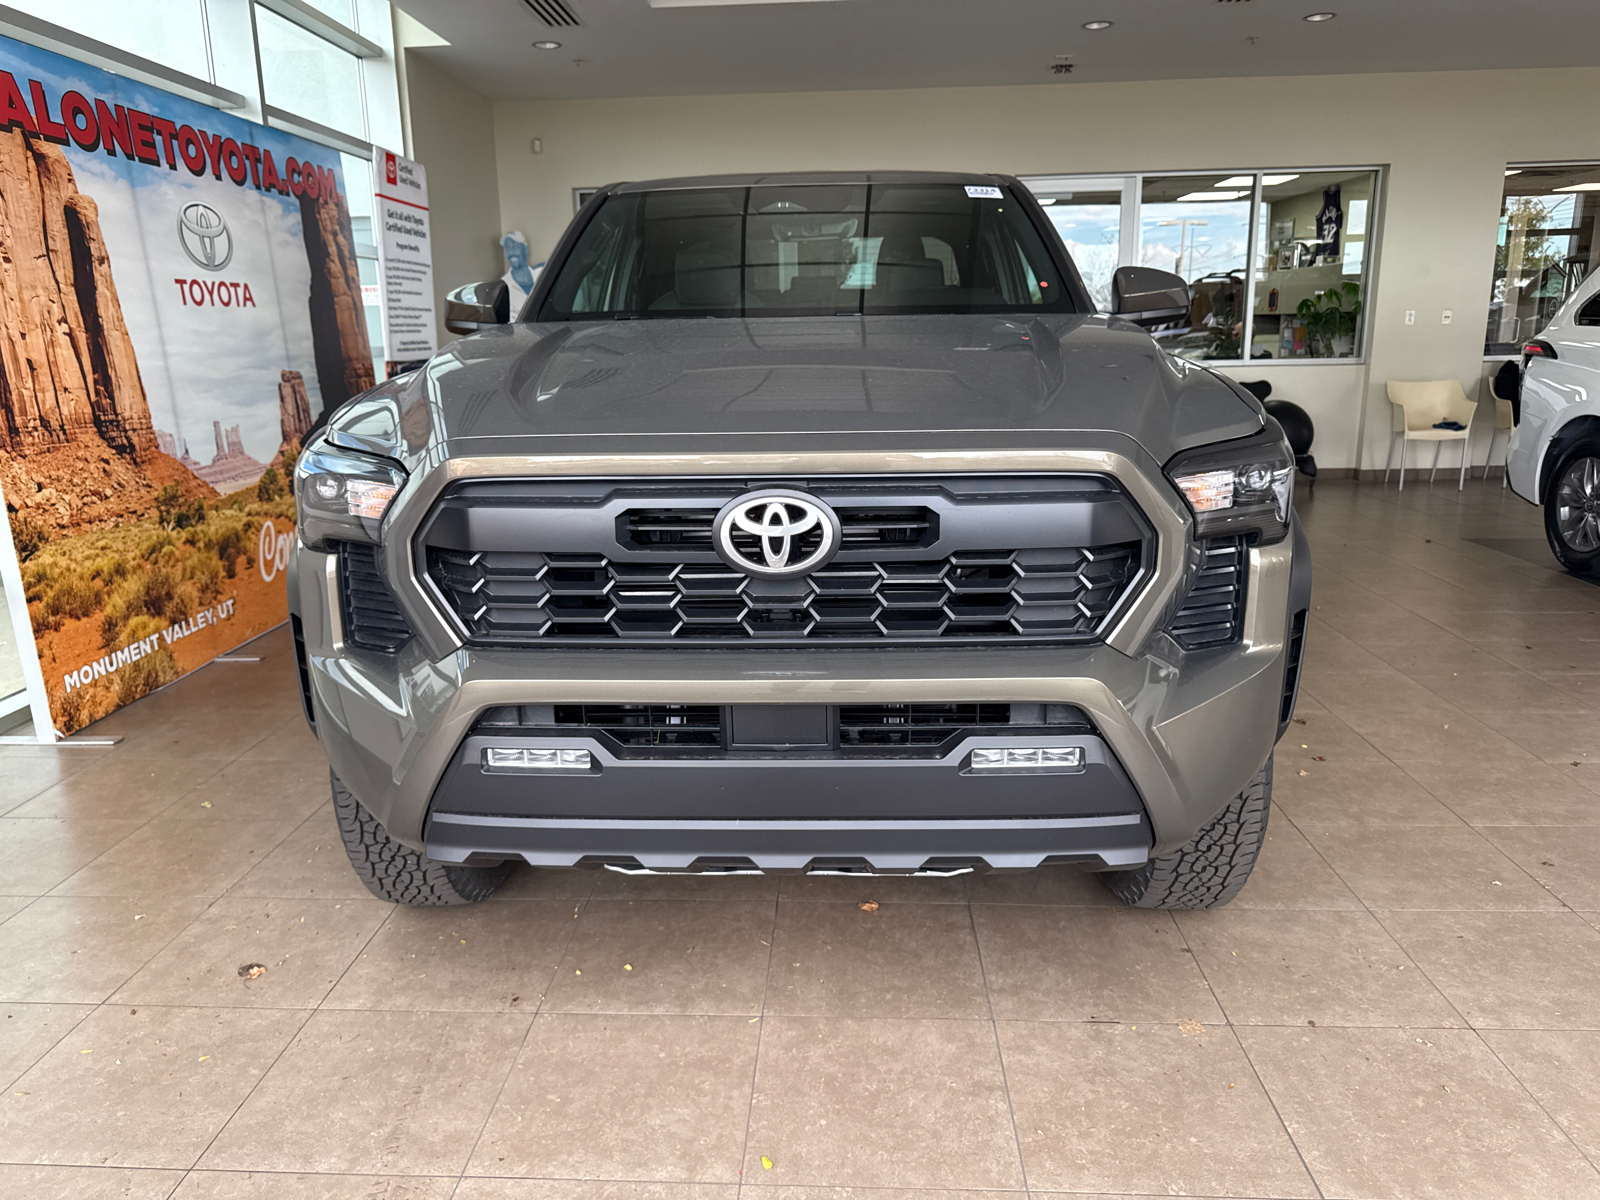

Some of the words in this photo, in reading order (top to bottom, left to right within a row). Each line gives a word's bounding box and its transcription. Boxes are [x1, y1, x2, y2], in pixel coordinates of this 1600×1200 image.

[174, 278, 256, 307] TOYOTA
[63, 632, 160, 693] MONUMENT
[162, 607, 217, 645] VALLEY,
[217, 598, 235, 620] UT
